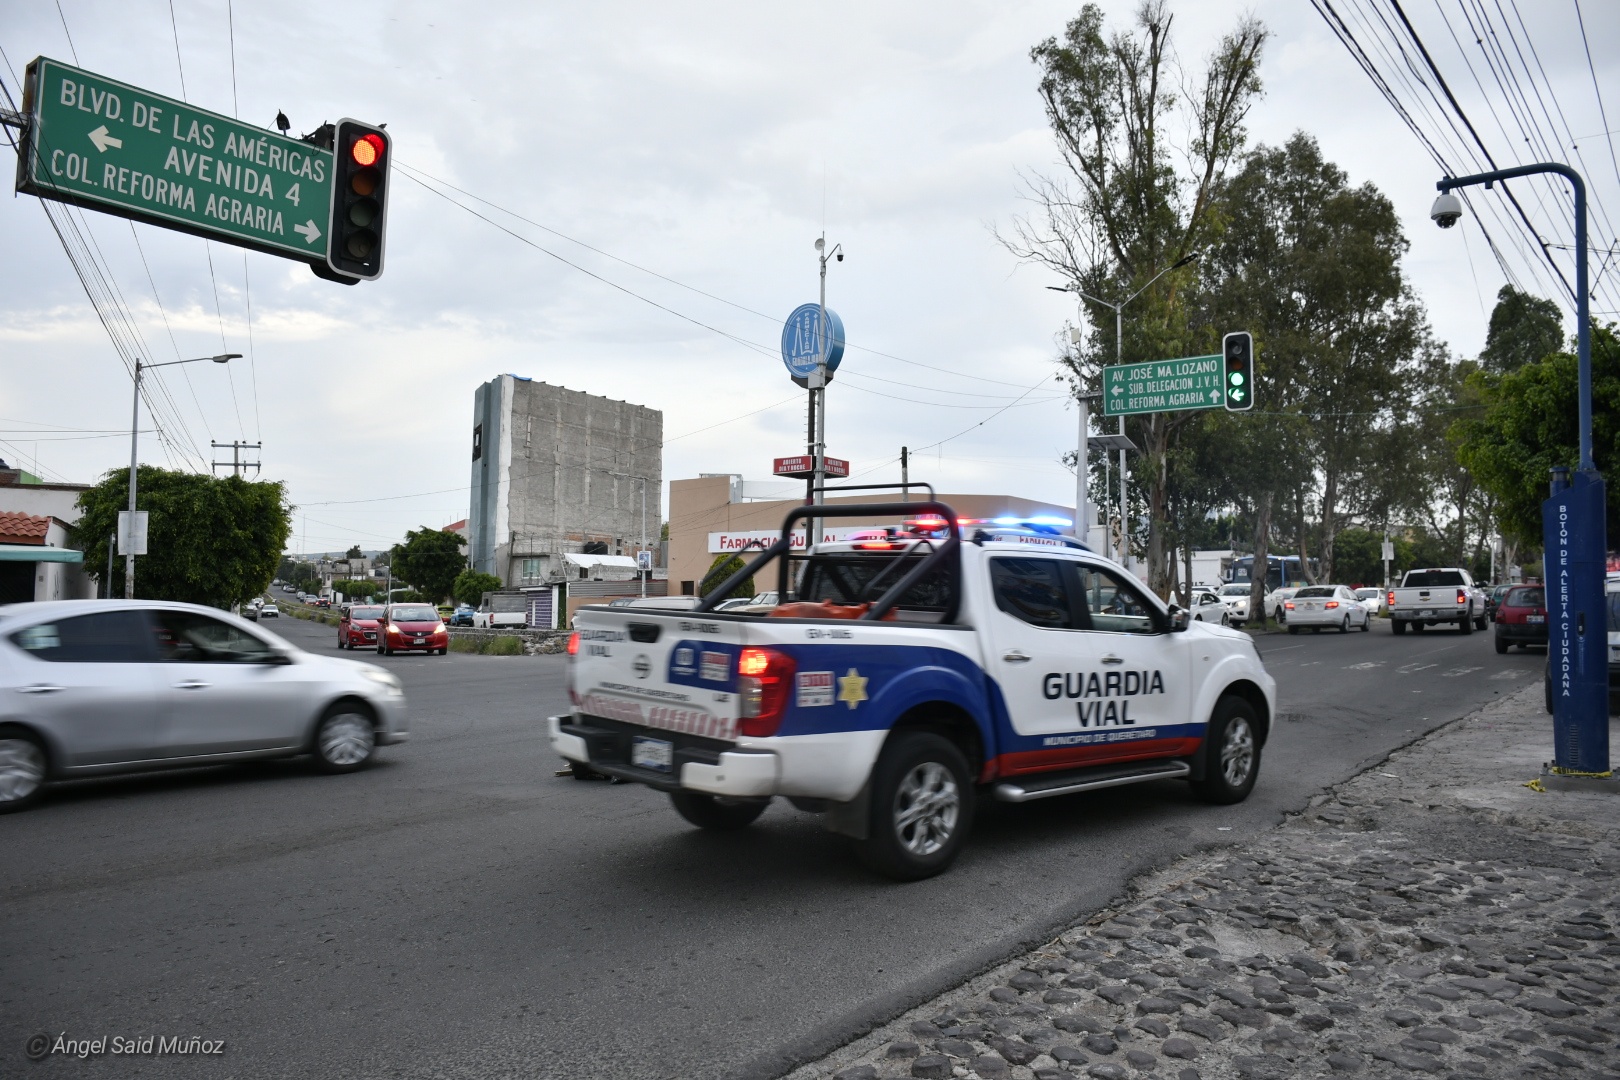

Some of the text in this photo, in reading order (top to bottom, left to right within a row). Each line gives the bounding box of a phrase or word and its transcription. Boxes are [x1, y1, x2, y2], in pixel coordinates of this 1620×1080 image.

[60, 78, 325, 183] BLVD. DE LAS AMÉRICAS
[164, 146, 300, 207] AVENIDA 4
[51, 149, 284, 236] COL. REFORMA AGRARIA
[1112, 360, 1218, 382] AV. JOSÉ MA. LOZANO
[1128, 382, 1146, 395] SUB.
[1146, 378, 1193, 393] DELEGACION
[1110, 392, 1205, 411] COL. REFORMA AGRARIA
[1559, 505, 1570, 697] BOTÓN DE ALERTA CIUDADANA
[1043, 669, 1165, 700] GUARDIA
[1076, 700, 1136, 727] VIAL
[1043, 735, 1092, 746] MUNICIPIO
[1092, 733, 1107, 743] DE
